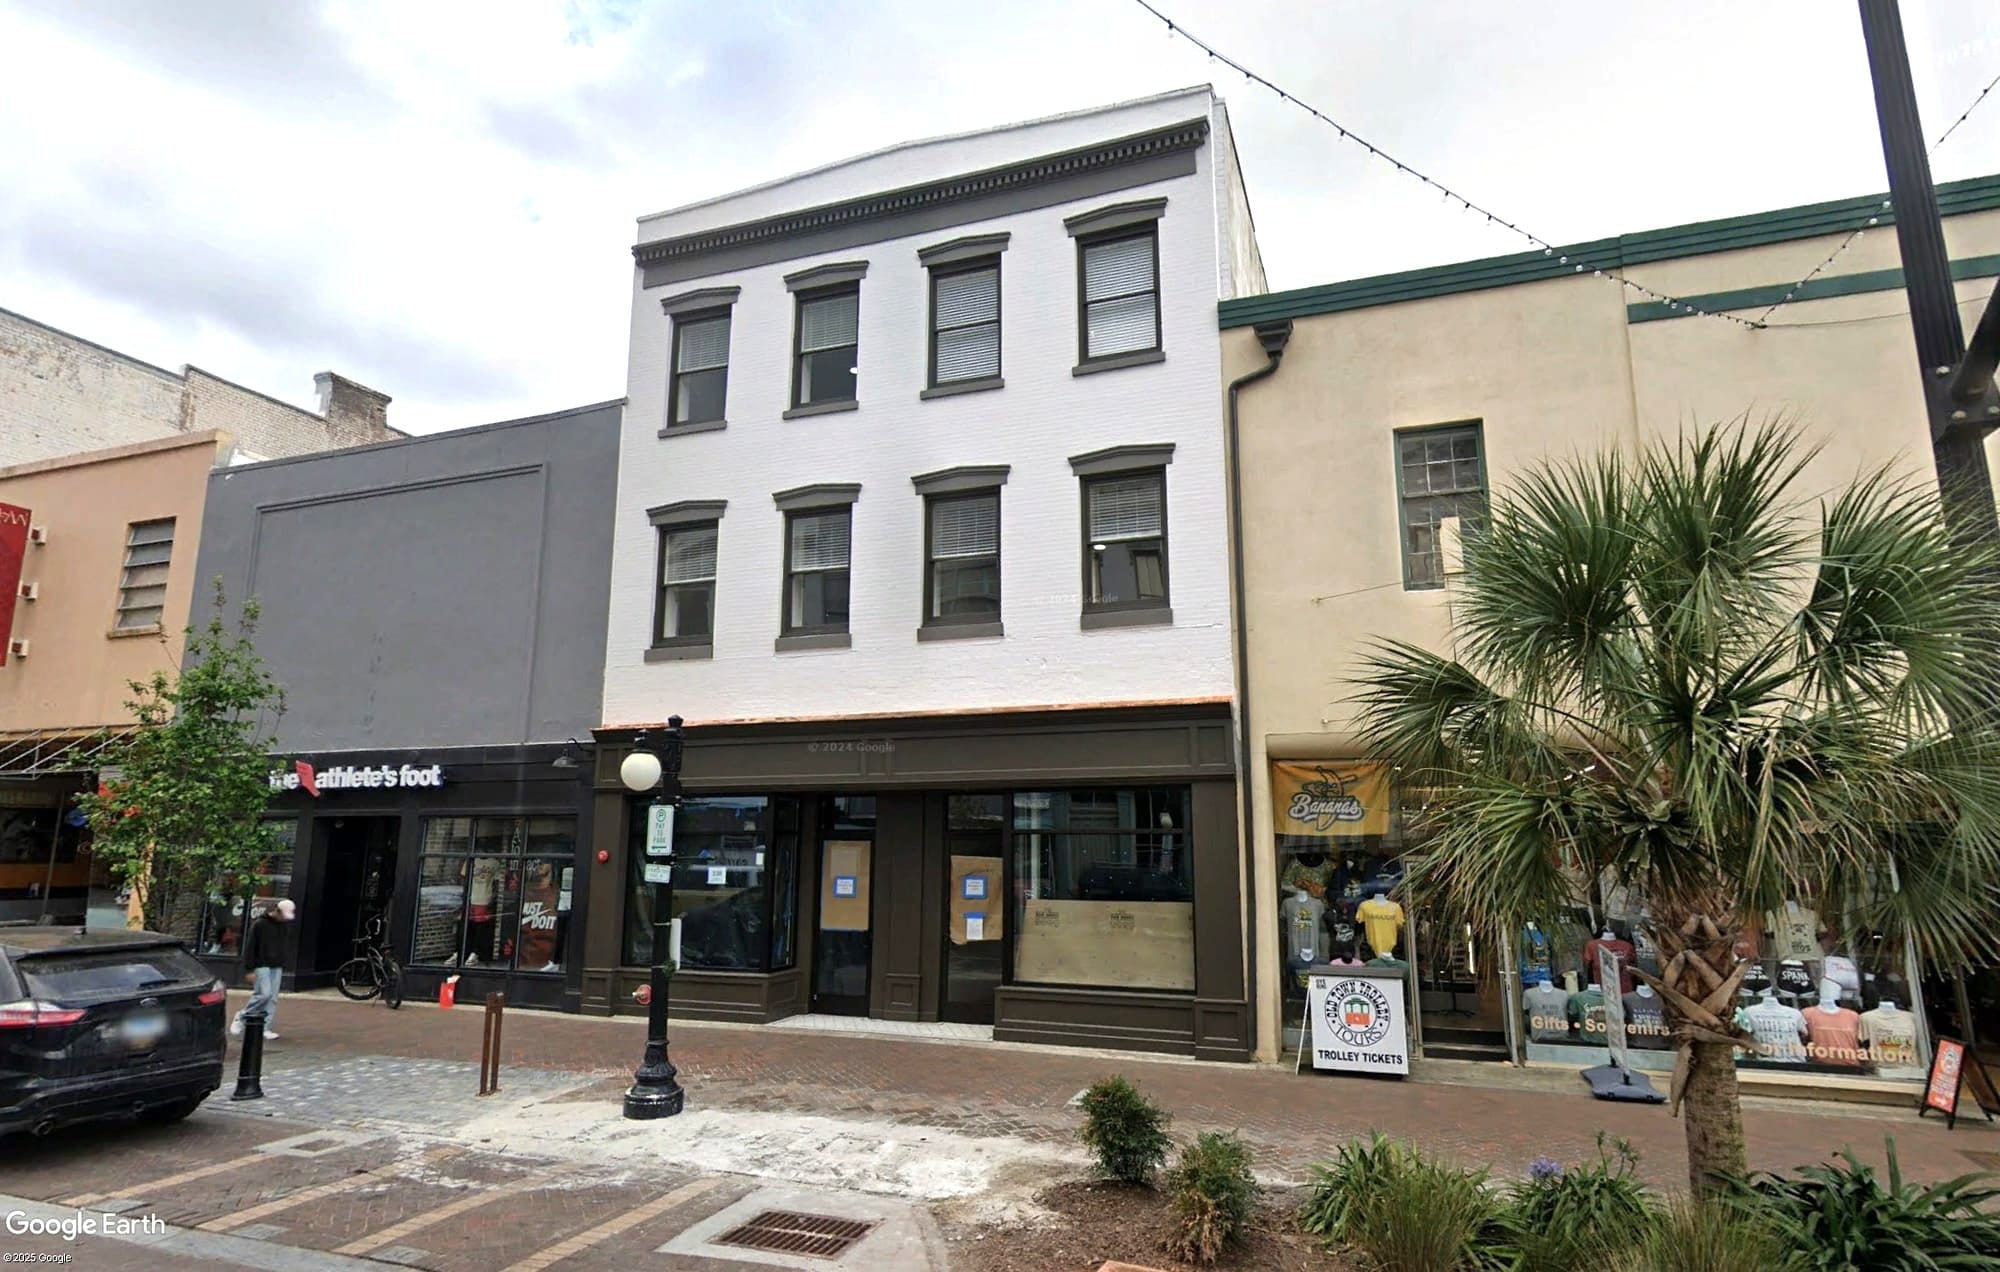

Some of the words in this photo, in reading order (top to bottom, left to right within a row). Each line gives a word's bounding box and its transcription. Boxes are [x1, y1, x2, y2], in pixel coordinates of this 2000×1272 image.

[315, 765, 398, 789] athlete's
[400, 764, 442, 788] foot
[1289, 793, 1363, 822] Bananas
[522, 902, 543, 915] JUST
[531, 915, 546, 929] DO
[546, 916, 557, 929] IT
[1331, 982, 1356, 1000] TOWN
[1326, 1000, 1338, 1018] OLD
[1359, 982, 1389, 1021] TROLLEY
[1336, 1025, 1382, 1045] TOURS
[1531, 1016, 1569, 1031] Gifts
[1585, 1018, 1671, 1037] Soenirs
[1318, 1049, 1360, 1062] TROLLEY
[1362, 1052, 1403, 1065] TICKETS
[1789, 1041, 1915, 1063] Information
